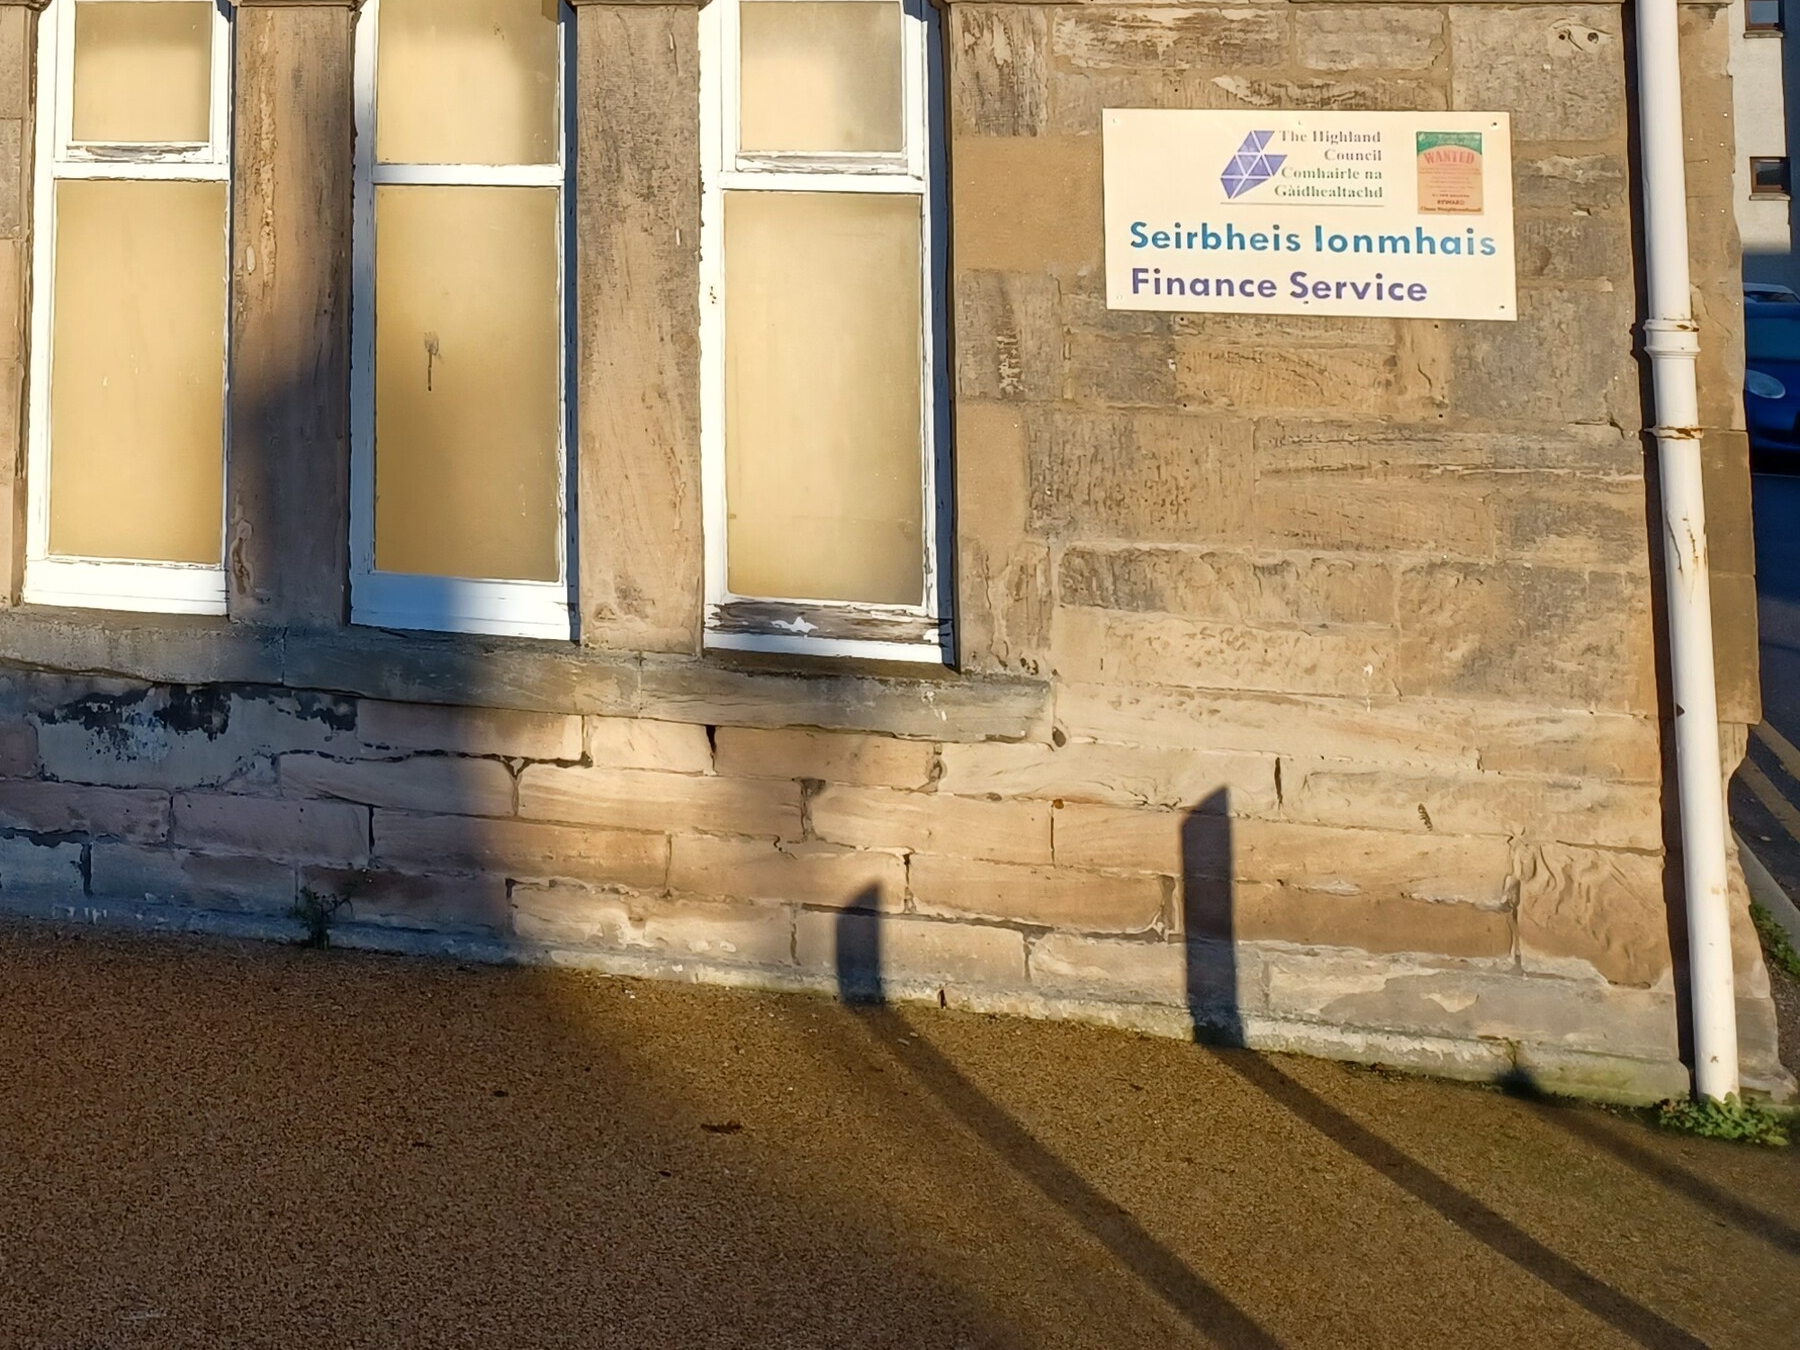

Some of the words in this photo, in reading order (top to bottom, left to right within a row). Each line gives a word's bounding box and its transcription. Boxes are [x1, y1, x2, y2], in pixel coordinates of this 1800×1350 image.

[1279, 130, 1307, 142] The
[1313, 130, 1381, 145] Highland
[1324, 149, 1382, 161] Council
[1424, 150, 1475, 164] WANTED
[1281, 167, 1360, 179] Comhairle
[1365, 171, 1382, 180] na
[1130, 221, 1301, 251] Seirbheis
[1315, 225, 1496, 256] Ionmhais
[1132, 267, 1277, 298] Finance
[1289, 271, 1428, 302] Service
